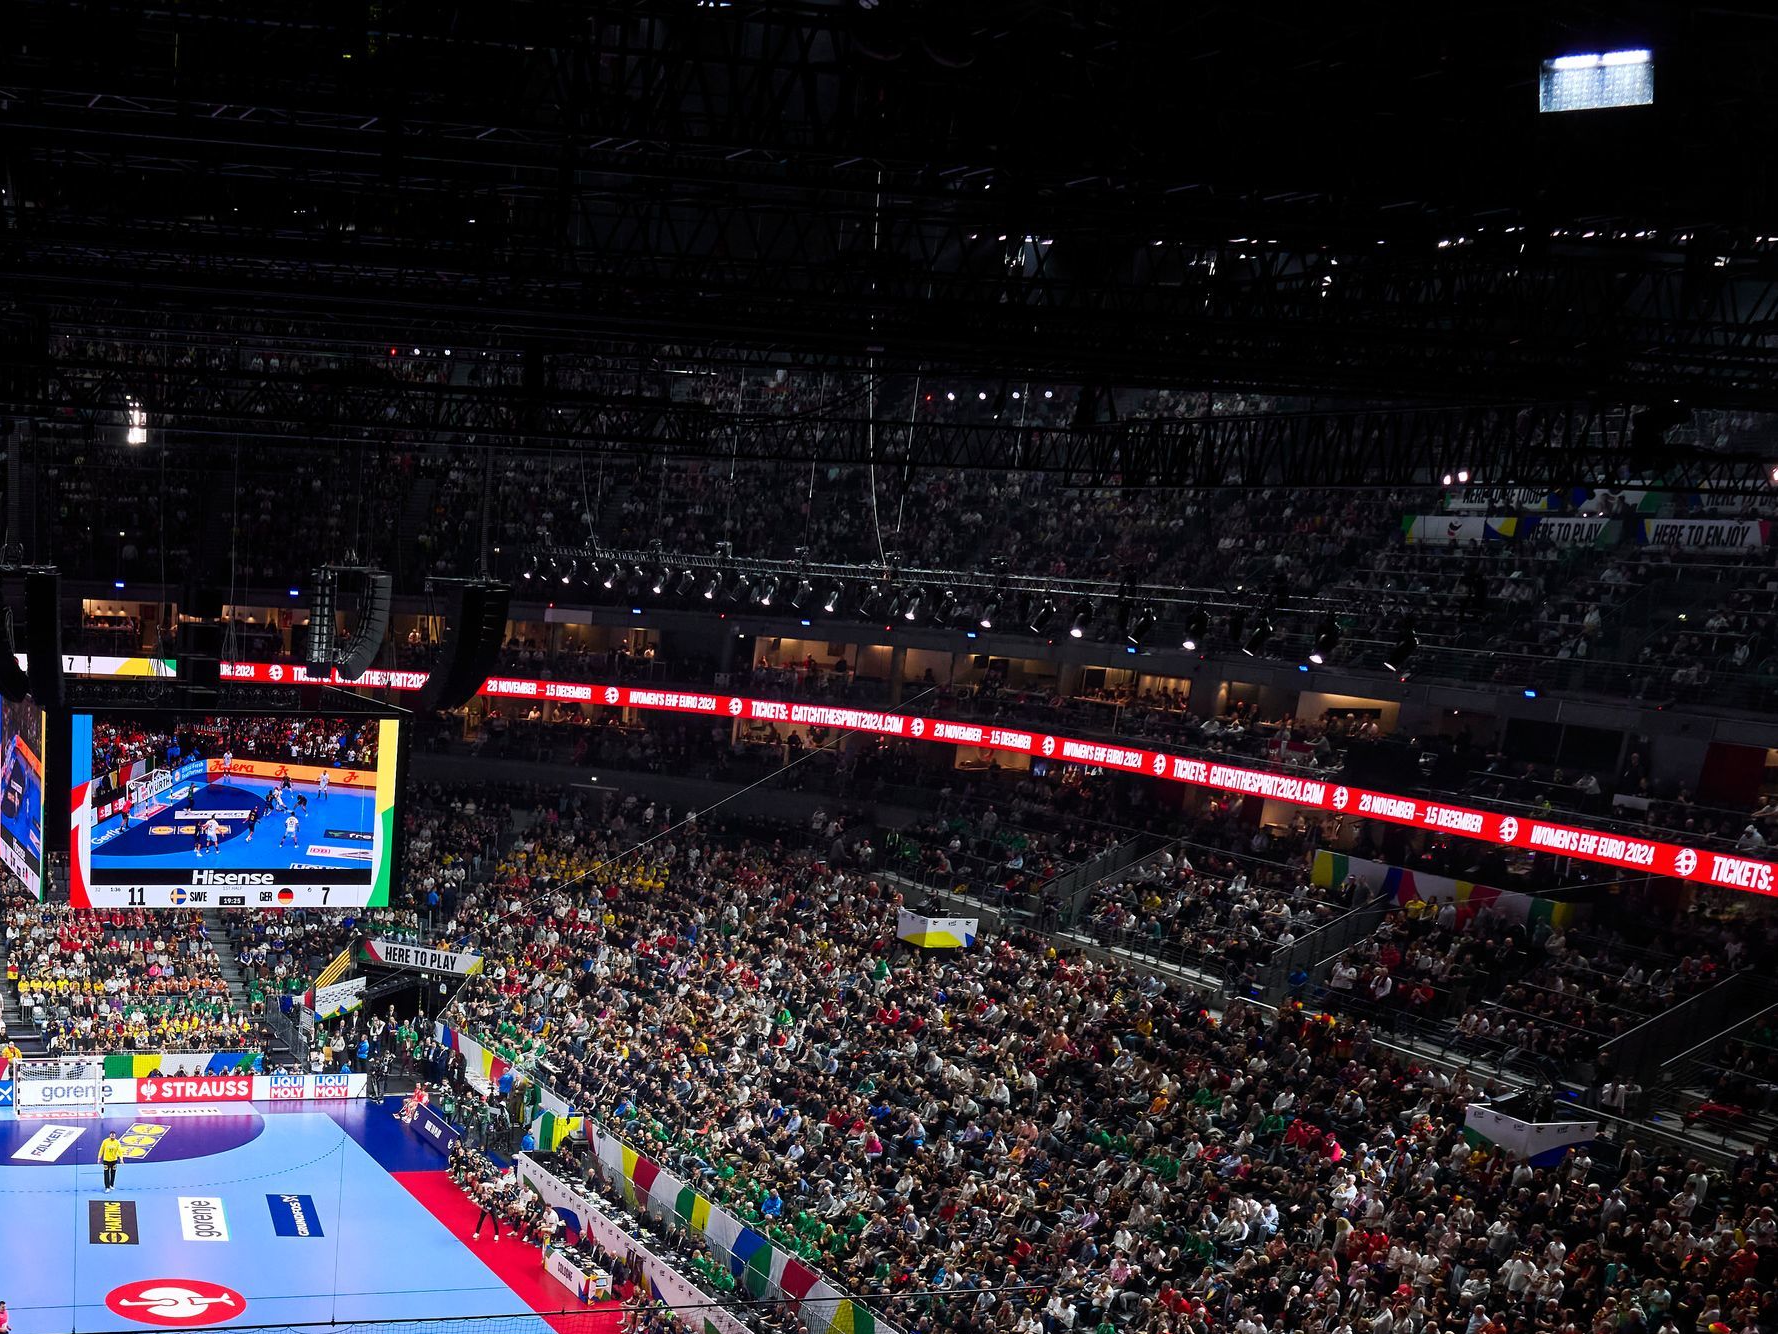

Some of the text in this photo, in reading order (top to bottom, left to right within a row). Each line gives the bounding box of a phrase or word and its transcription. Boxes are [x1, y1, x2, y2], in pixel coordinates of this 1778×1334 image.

[1653, 525, 1751, 546] HERE TO ENJOY
[67, 657, 74, 670] 7
[235, 665, 254, 678] 2024
[487, 679, 592, 700] 28 NOVEMBER 15 DECEMBER
[629, 690, 716, 710] WOMEN'S EHF EURO 2024
[751, 701, 903, 734] TICKETS: CATCHTHESPIRIT2024.COM
[934, 723, 1032, 749] 28 NOVEMBER 15 DECEMBER
[1062, 741, 1095, 760] WOMEN'S
[1105, 747, 1123, 765] EURO
[1123, 750, 1143, 768] 2024
[1173, 758, 1326, 805] TICKETS: CATCHTHESPIRIT2024.COM
[1358, 794, 1484, 833] 28 NOVEMBER 15 DECEMBER
[1530, 825, 1656, 866] WOMEN'S EHF EURO 2024
[192, 869, 275, 886] Hisense
[1711, 855, 1775, 891] TICKETS:
[128, 887, 146, 906] 11
[189, 891, 207, 902] SWE
[259, 891, 272, 902] GER
[322, 887, 330, 906] 7
[385, 946, 457, 971] HERE TO PLAY
[162, 1080, 249, 1098] STRAUSS
[271, 1076, 304, 1087] LIQUI
[316, 1076, 348, 1087] LIQUI
[41, 1084, 113, 1102] gorenje
[271, 1087, 304, 1098] MOLY
[316, 1087, 348, 1098] MOLY
[31, 1128, 66, 1156] FALKEN
[106, 1202, 122, 1231] HARTING
[184, 1200, 222, 1238] gorenje
[289, 1201, 309, 1236] GRUNDFOS
[557, 1262, 573, 1281] COLOGNE
